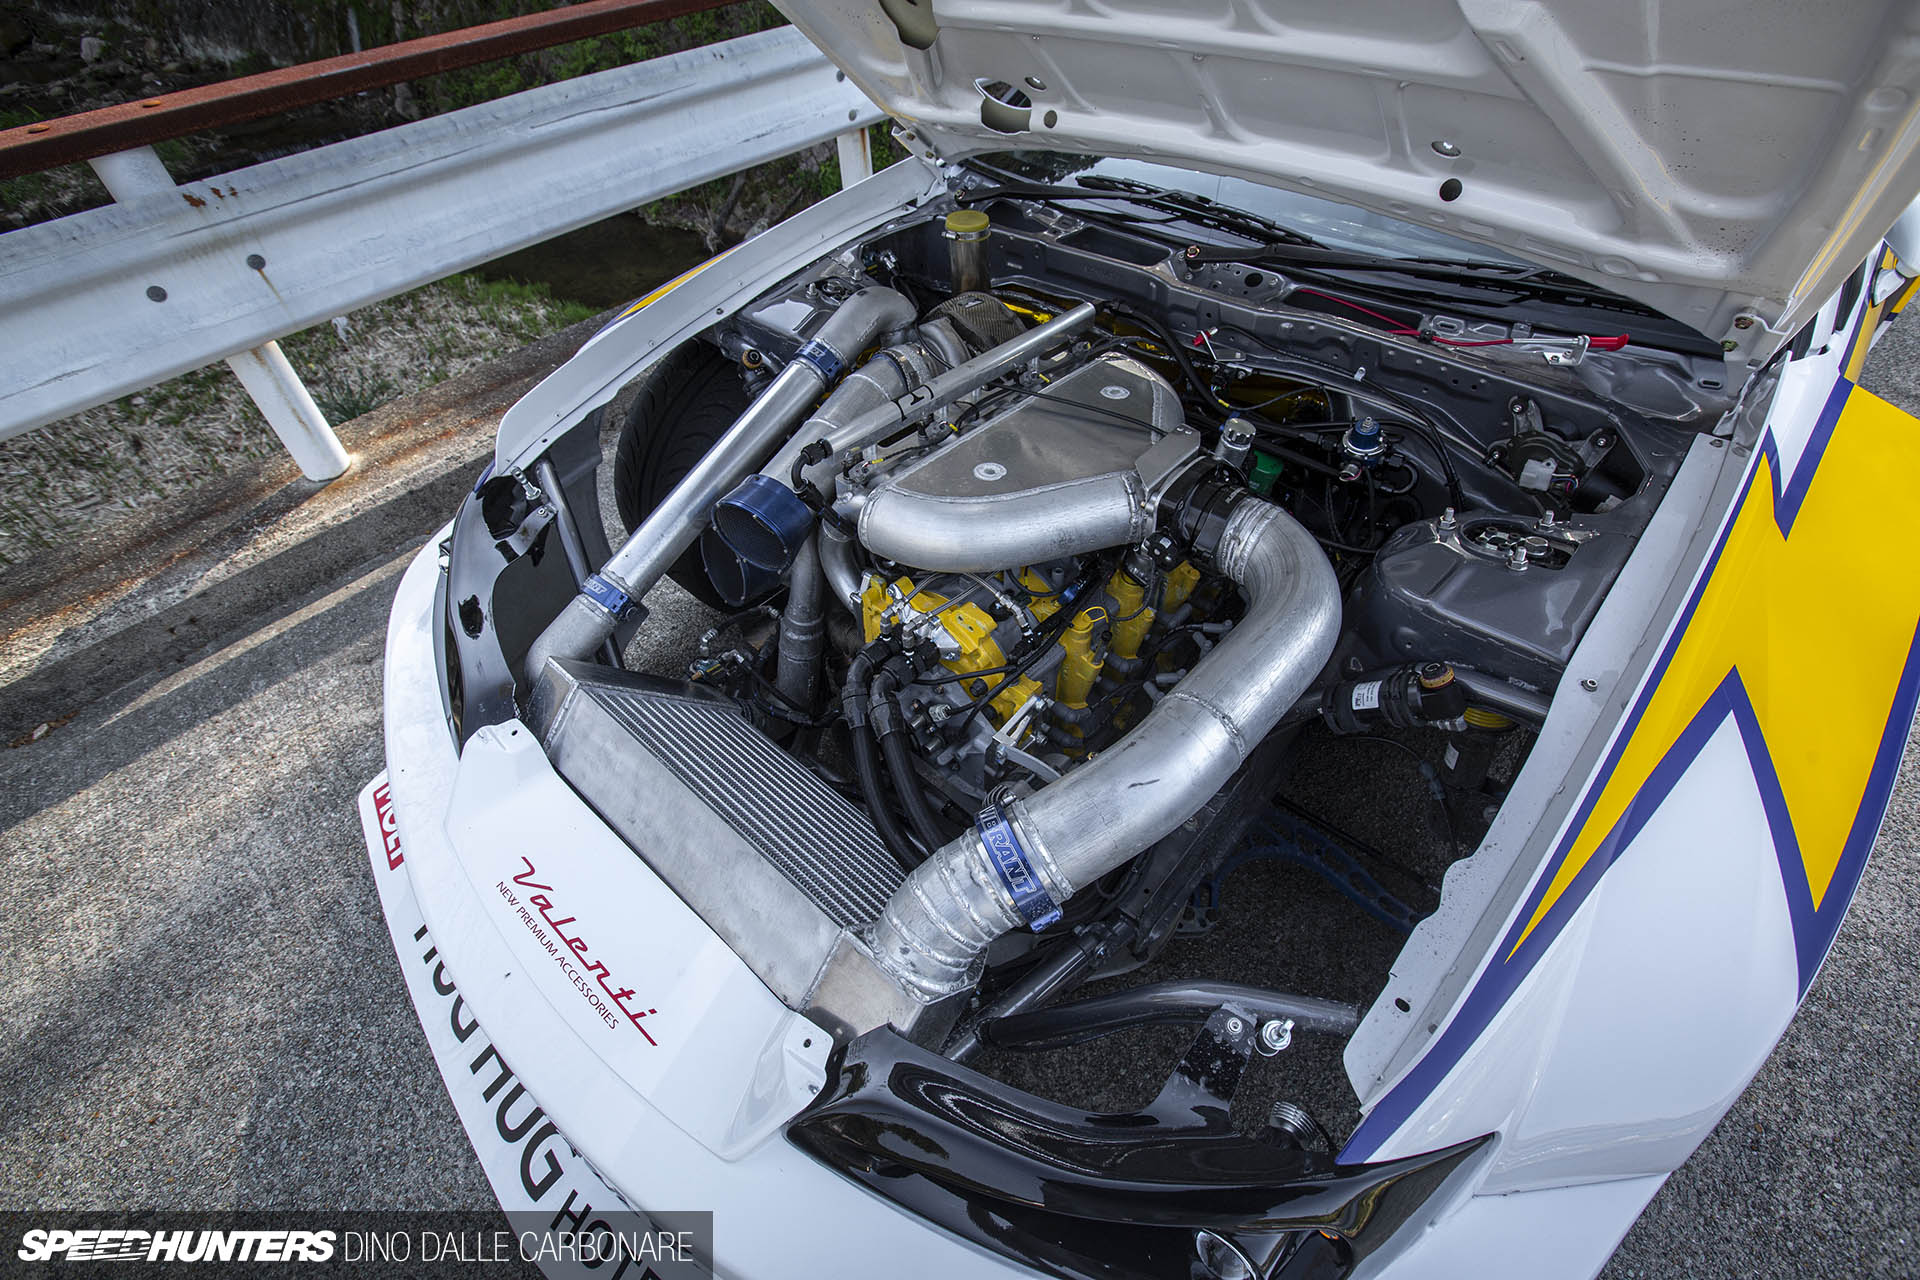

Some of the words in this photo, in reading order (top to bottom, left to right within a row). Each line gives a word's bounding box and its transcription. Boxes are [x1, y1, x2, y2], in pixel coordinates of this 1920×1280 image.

[496, 881, 520, 906] NEW
[516, 906, 559, 957] PREMIUM
[555, 956, 619, 1030] ACCESSORIES
[513, 856, 658, 1046] Valenti
[550, 1189, 664, 1280] HOT
